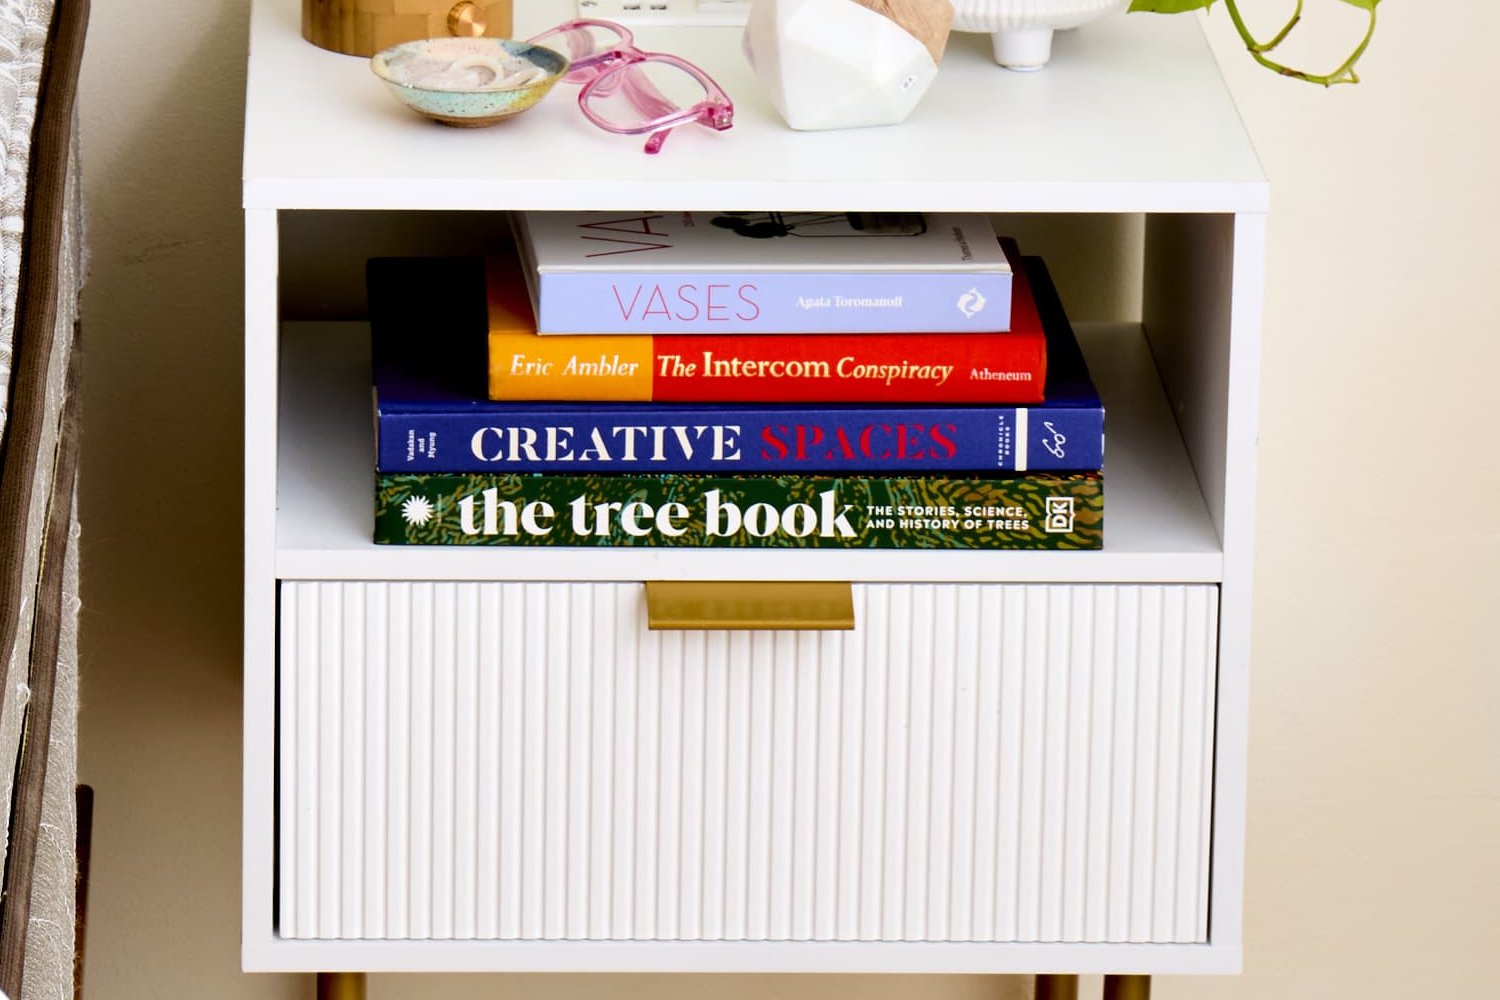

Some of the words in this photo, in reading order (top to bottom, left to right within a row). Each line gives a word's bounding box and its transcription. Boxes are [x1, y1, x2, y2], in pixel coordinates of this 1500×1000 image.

[577, 211, 673, 258] VA
[612, 284, 760, 321] VASES
[796, 296, 831, 310] Agata
[832, 295, 903, 308] Toromanoff
[509, 353, 554, 376] Eric
[562, 354, 639, 377] Ambler
[657, 355, 696, 377] The
[702, 351, 830, 377] Intercom
[836, 356, 954, 386] Conspiracy
[970, 367, 1032, 382] Atheneum
[470, 425, 741, 462] CREATIVE
[760, 423, 958, 461] SPACES
[457, 487, 555, 536] the
[569, 495, 690, 537] tree
[704, 489, 858, 537] book
[866, 505, 893, 516] THE
[897, 505, 959, 518] STORIES,
[964, 506, 1028, 519] SCIENCE,
[866, 519, 895, 529] AND
[899, 518, 960, 530] HISTORY
[963, 519, 983, 530] OF
[986, 519, 1029, 530] TREES
[1051, 502, 1068, 528] DK
